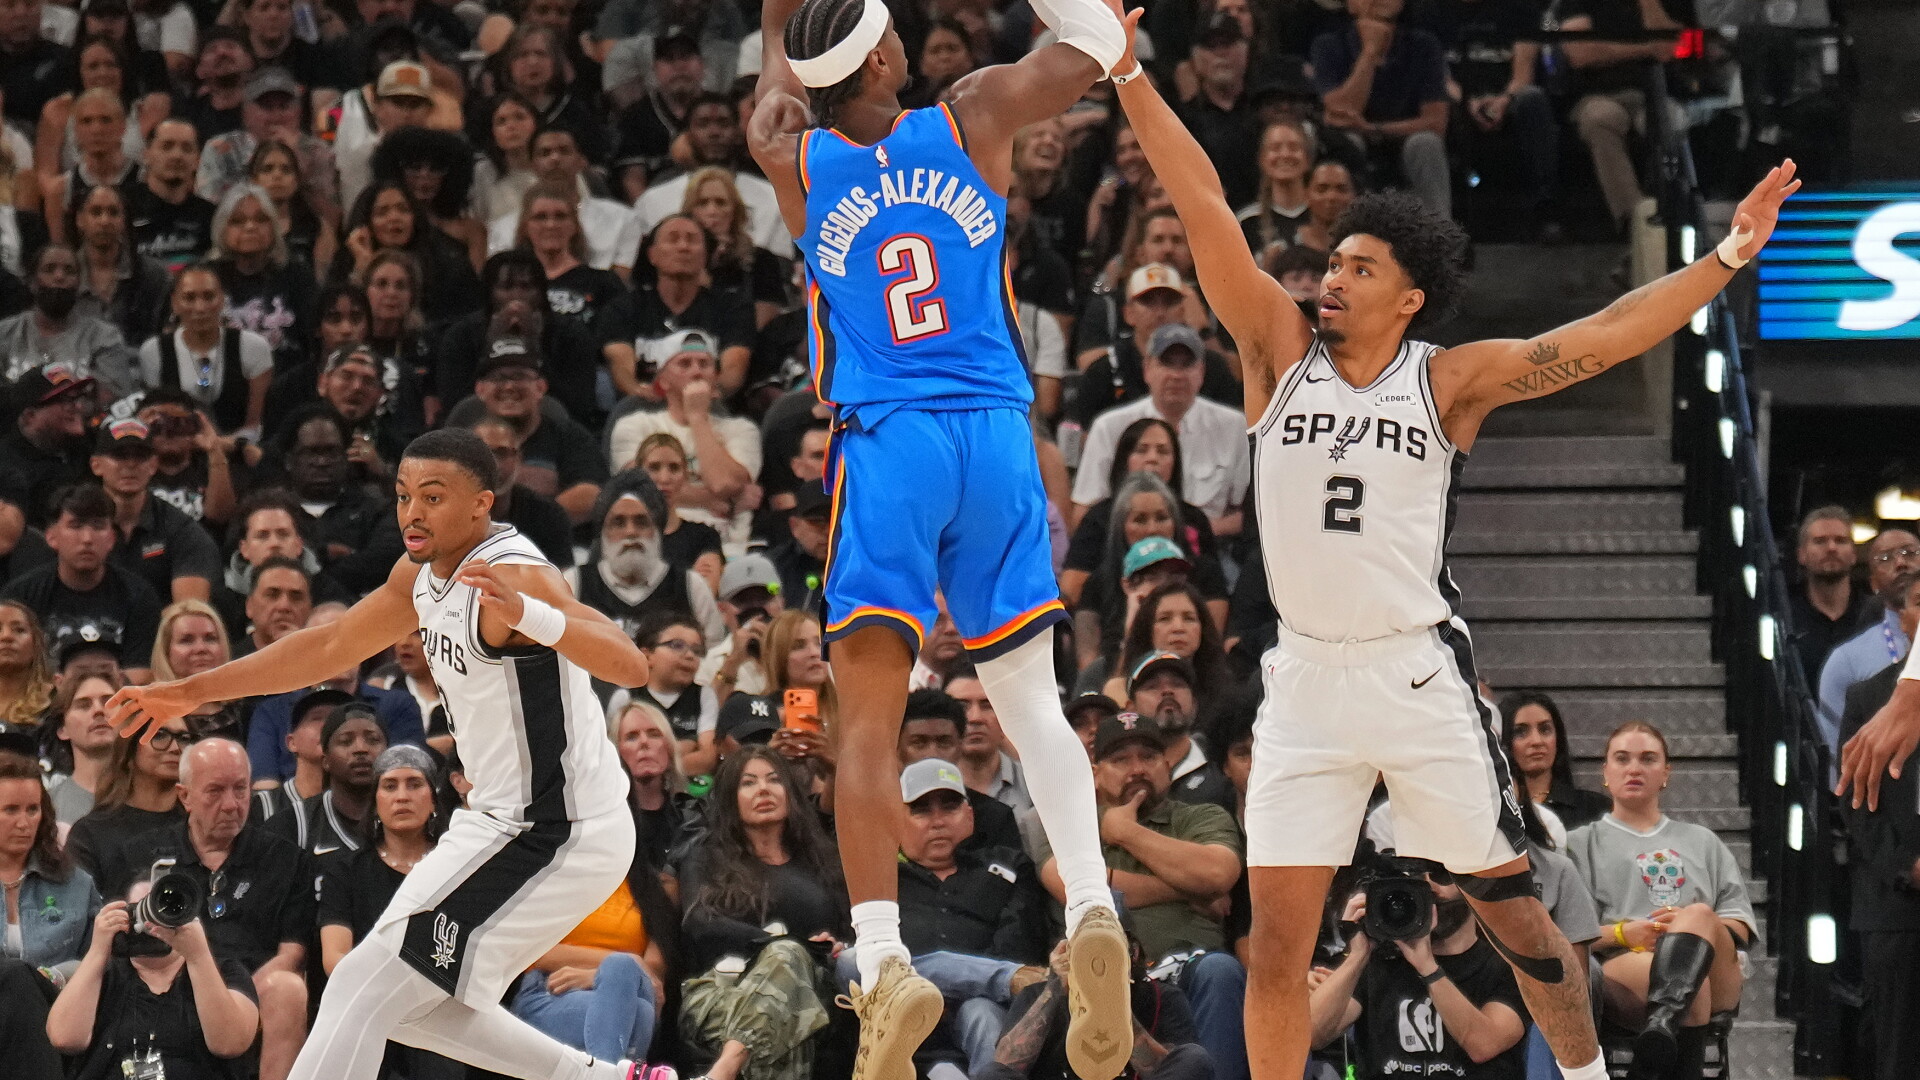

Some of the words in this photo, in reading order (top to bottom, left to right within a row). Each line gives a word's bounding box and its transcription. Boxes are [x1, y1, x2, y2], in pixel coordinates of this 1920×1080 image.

[818, 167, 997, 277] GILGEOUS-ALEXANDER
[877, 233, 949, 345] 2
[1502, 353, 1606, 395] WAWG
[1282, 413, 1427, 464] SPURS
[1321, 473, 1366, 536] 2
[420, 627, 468, 676] PURS
